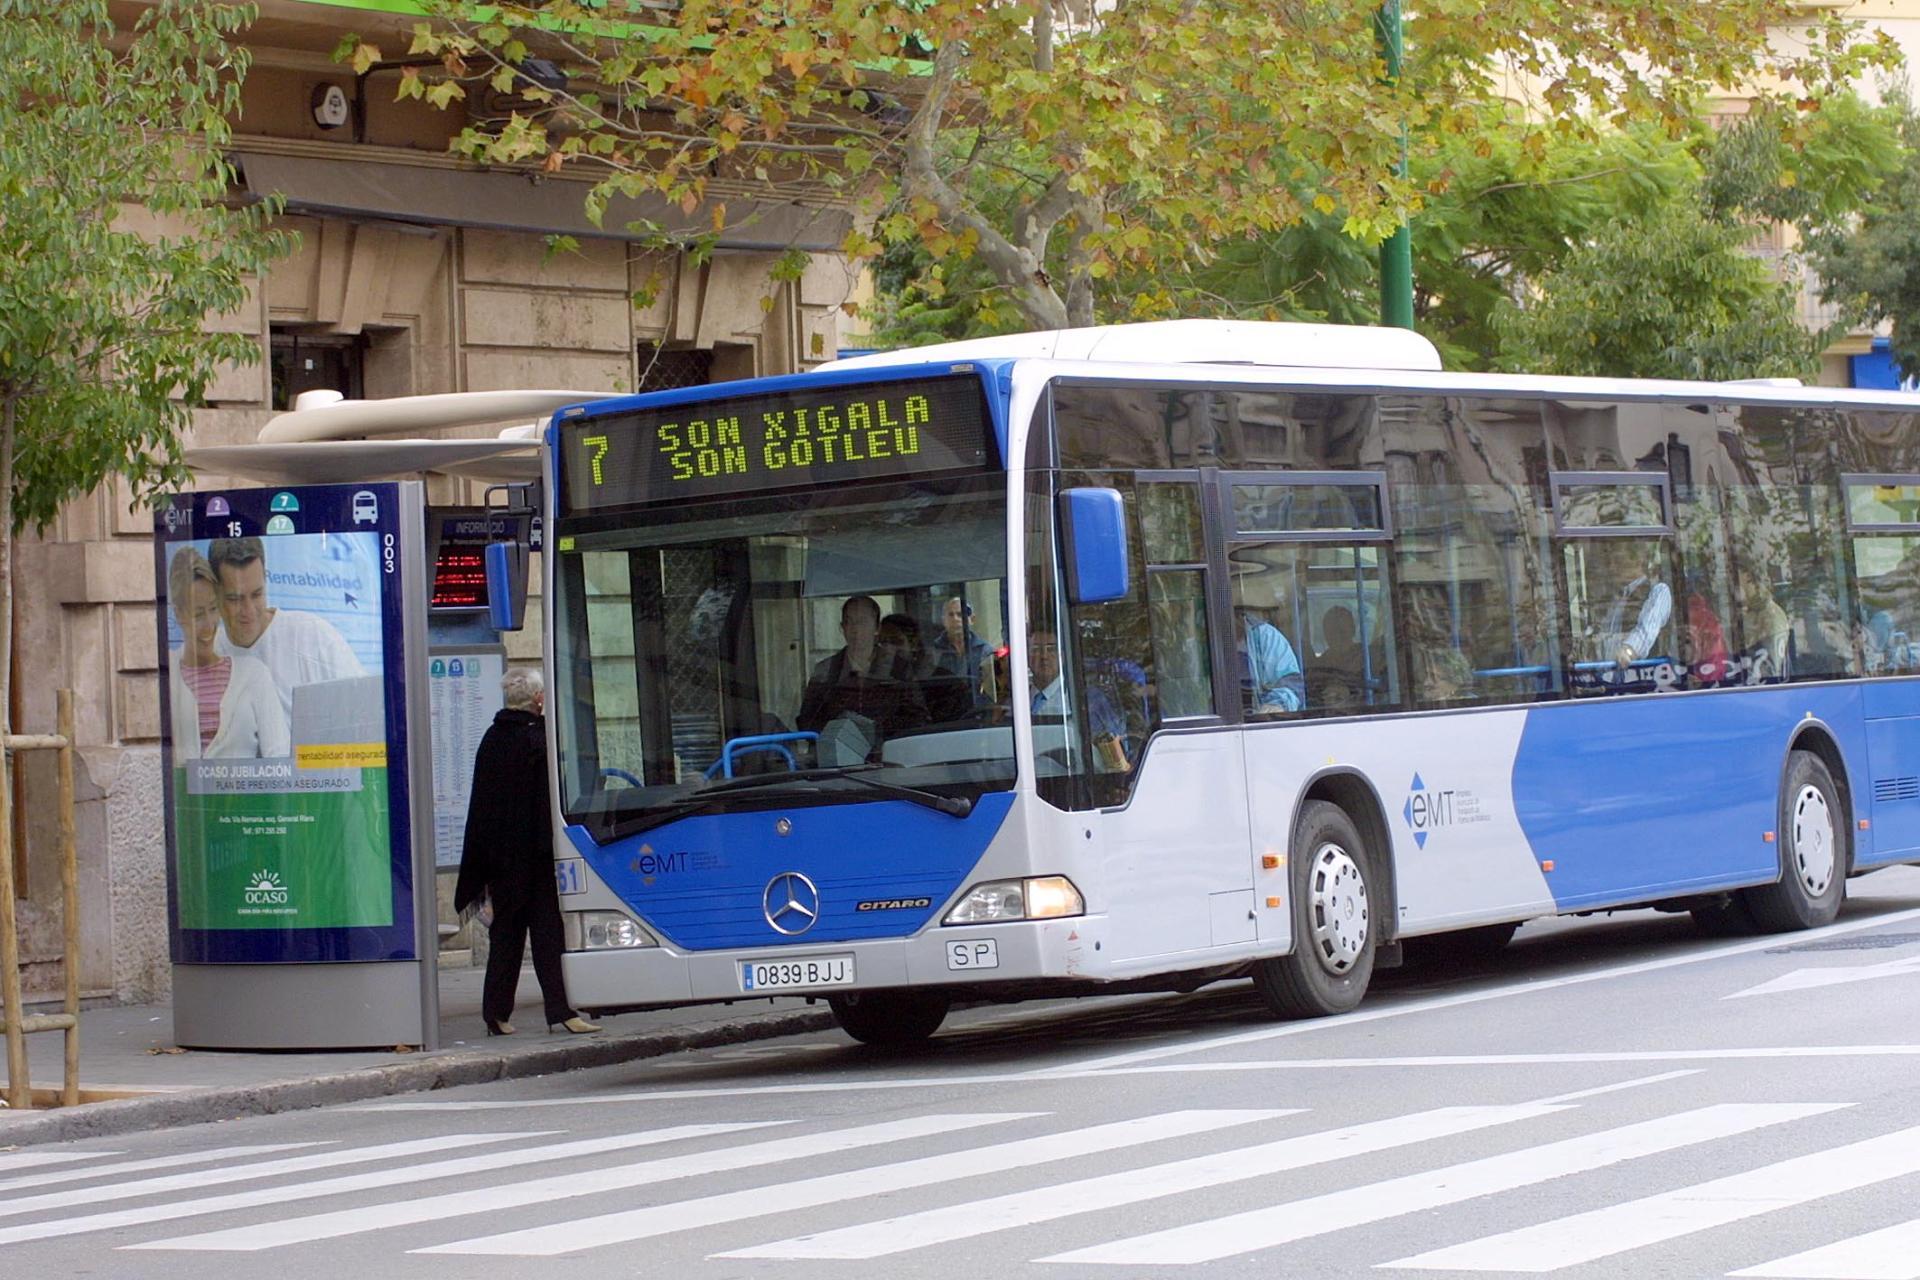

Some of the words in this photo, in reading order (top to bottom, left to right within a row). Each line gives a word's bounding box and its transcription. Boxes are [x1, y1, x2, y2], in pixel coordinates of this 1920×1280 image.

[657, 416, 741, 453] SON
[763, 395, 932, 441] XIGALA
[582, 435, 609, 486] 7
[670, 446, 748, 481] SON
[763, 426, 921, 470] GOTLEU
[227, 521, 242, 537] 15
[275, 519, 288, 530] 17
[198, 766, 228, 779] OCASO
[230, 762, 292, 778] JUBILACIÓN
[216, 781, 234, 791] PLAN
[236, 781, 246, 790] DE
[294, 778, 350, 789] ASEGURADO
[245, 891, 288, 904] OCASO
[858, 898, 930, 912] CITARO
[757, 964, 802, 986] 0839
[808, 961, 845, 983] BJJ
